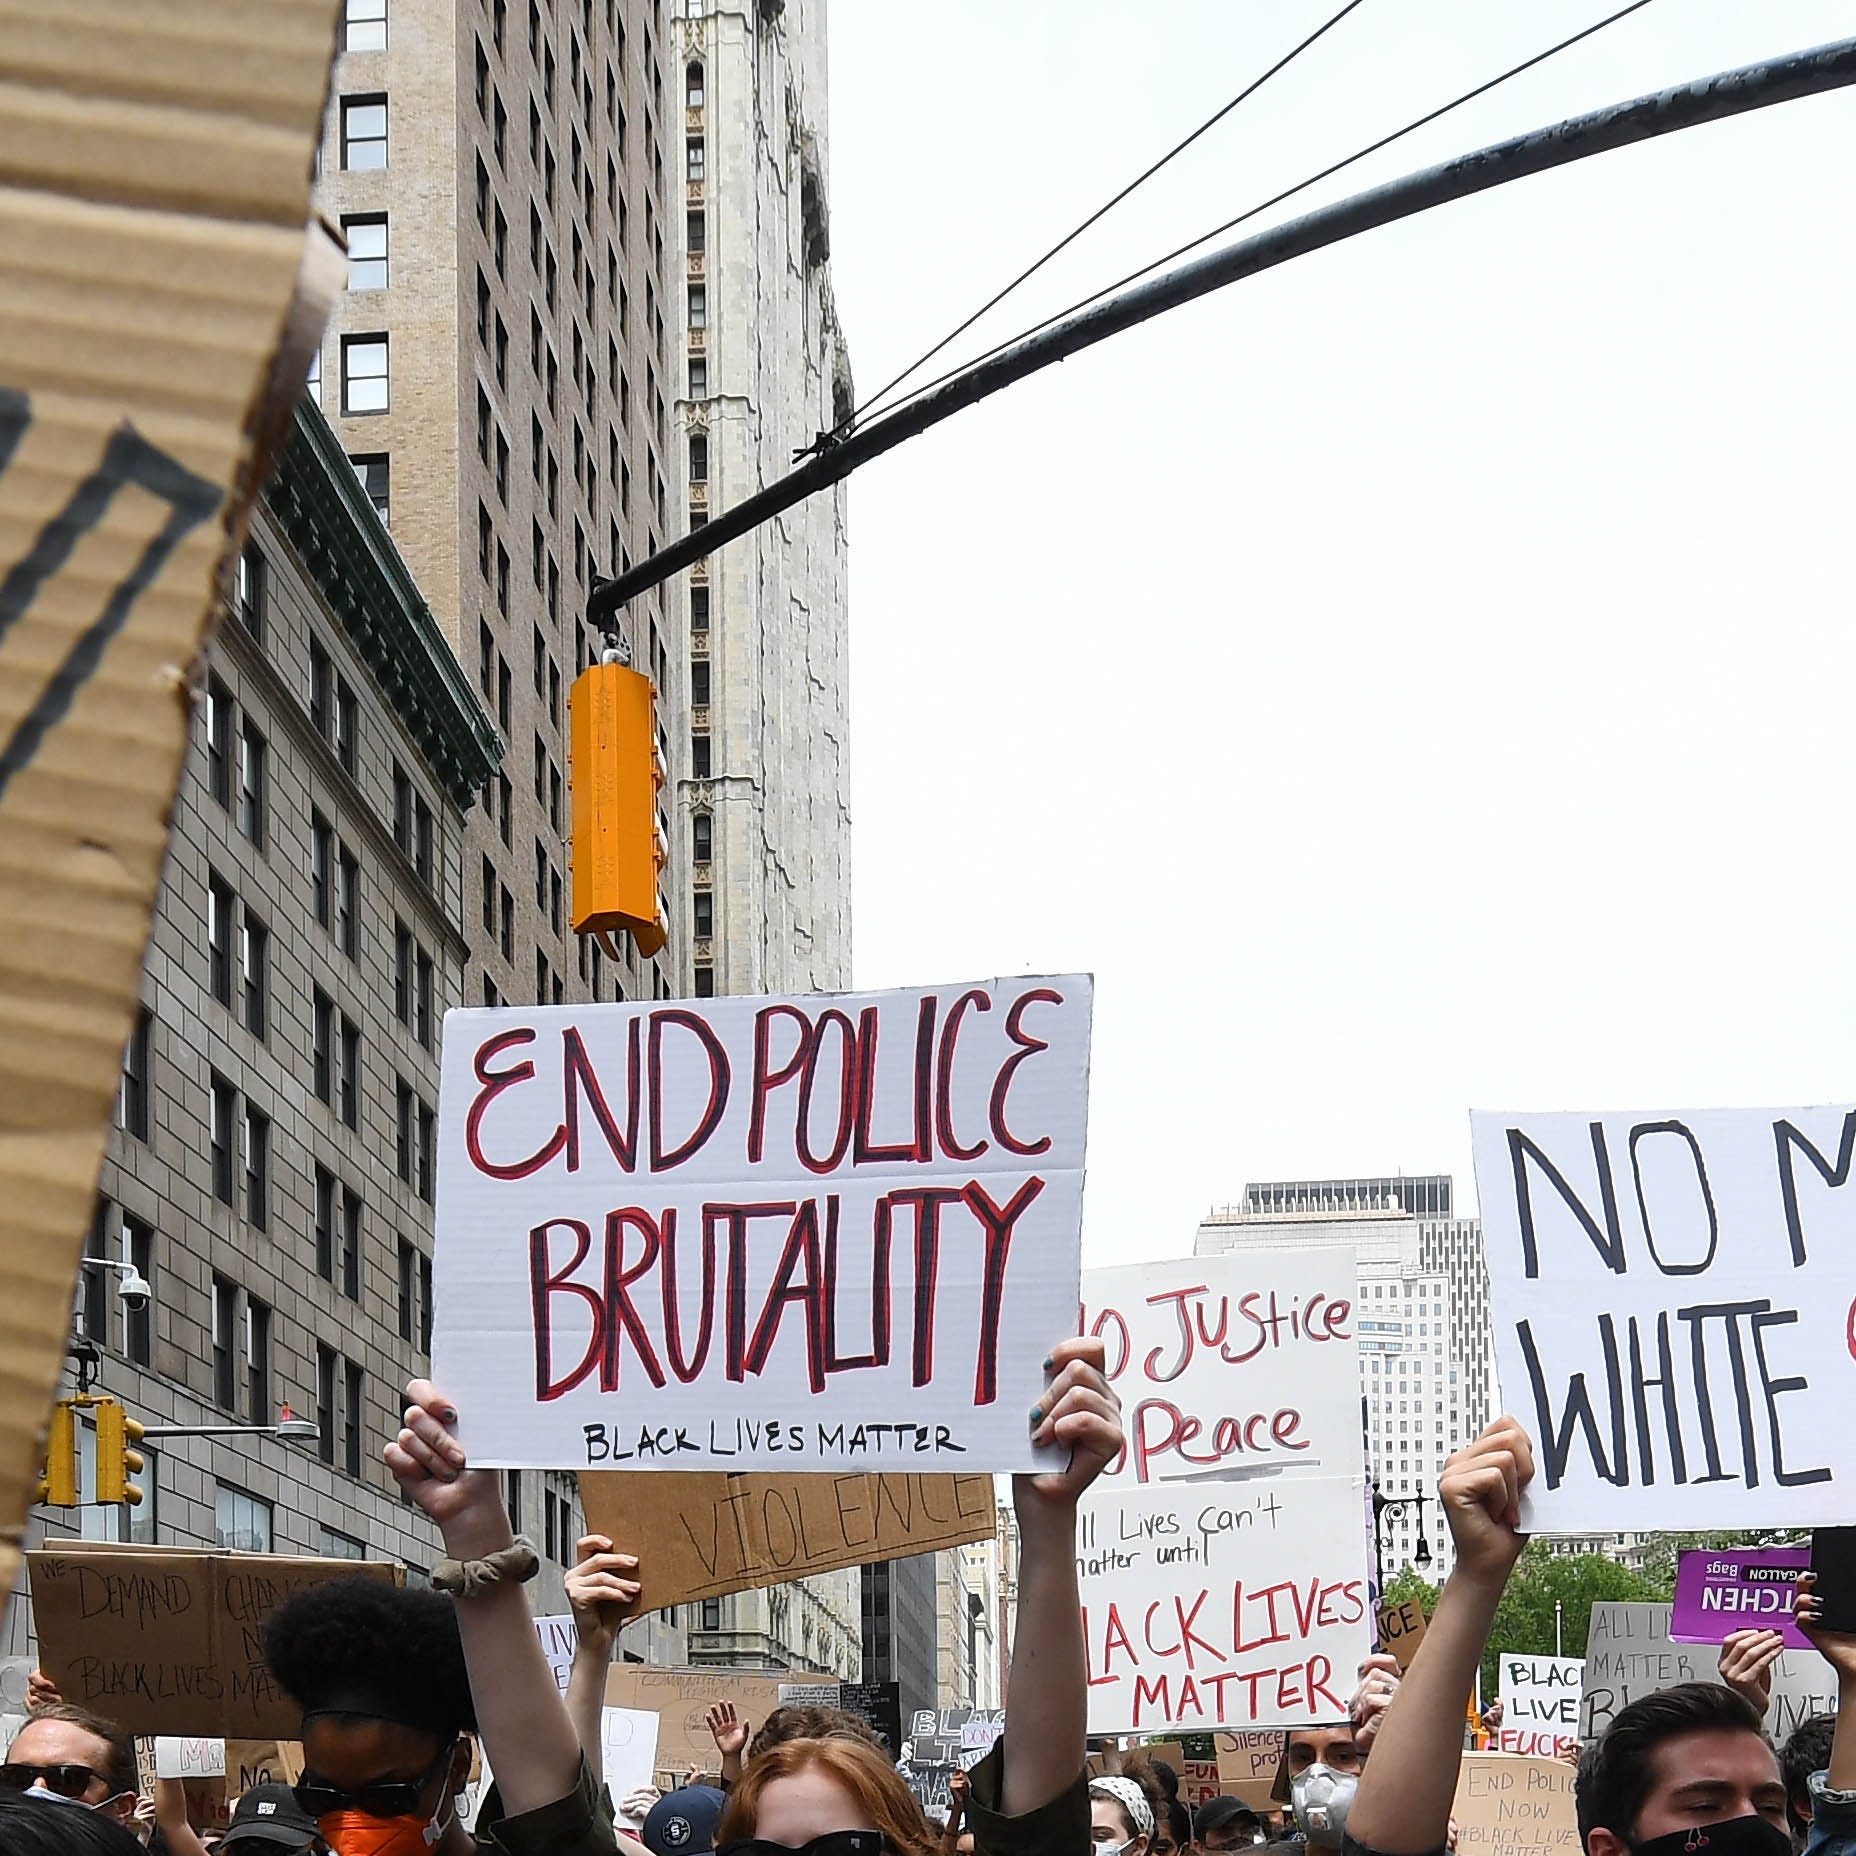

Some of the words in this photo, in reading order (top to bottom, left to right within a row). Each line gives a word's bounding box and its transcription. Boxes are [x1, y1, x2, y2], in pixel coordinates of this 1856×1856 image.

[466, 1014, 732, 1180] END
[749, 988, 1065, 1175] POLICE
[1506, 1119, 1717, 1279] NO
[529, 1176, 1046, 1405] BRUTALITY
[1079, 1302, 1130, 1381] O
[1516, 1299, 1832, 1490] WHITE
[583, 1425, 700, 1465] BLACK
[708, 1418, 805, 1456] LIVES
[819, 1423, 967, 1457] MATTER
[1133, 1398, 1310, 1483] Peace
[680, 1474, 986, 1577] VIOLENCE
[1120, 1509, 1180, 1541] Lives
[1705, 1560, 1738, 1577] Bags
[1749, 1568, 1798, 1581] GALLON
[41, 1559, 66, 1579] WE
[71, 1566, 191, 1630] DEMAND
[1701, 1586, 1793, 1613] TCHEN
[1081, 1589, 1228, 1686] LACK
[1234, 1576, 1364, 1653] LIVES
[1594, 1610, 1634, 1640] ALL
[1507, 1662, 1585, 1687] BLAC
[1594, 1653, 1695, 1680] MATTER
[1132, 1654, 1348, 1728] MATTER
[1512, 1698, 1578, 1723] LIVE
[1468, 1766, 1514, 1797] END
[1527, 1768, 1576, 1793] POLIC
[1498, 1799, 1551, 1822] NOW
[1535, 1829, 1582, 1848] LIVE
